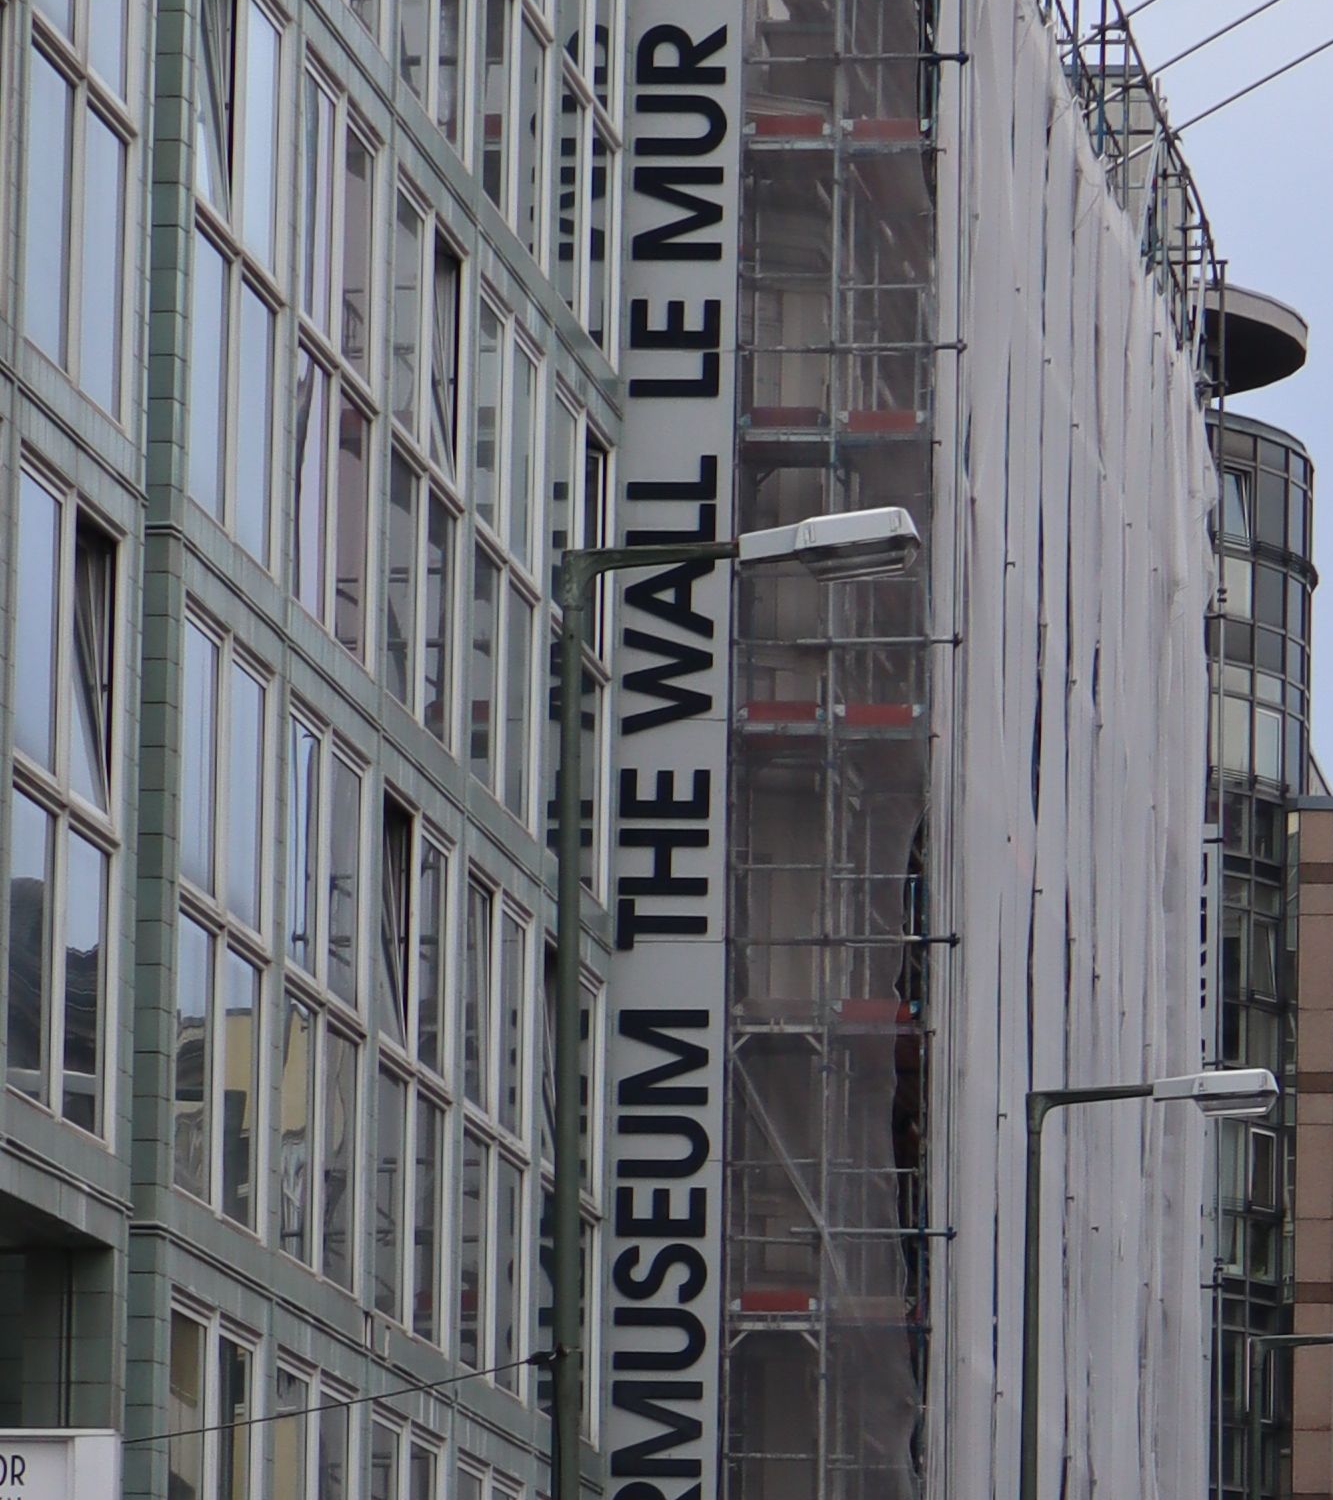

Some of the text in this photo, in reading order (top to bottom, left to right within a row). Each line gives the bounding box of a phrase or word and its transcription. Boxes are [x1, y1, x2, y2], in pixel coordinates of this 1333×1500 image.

[631, 23, 728, 261] MUR
[628, 298, 721, 398] LE
[620, 454, 718, 734] WALL
[617, 768, 711, 950] THE
